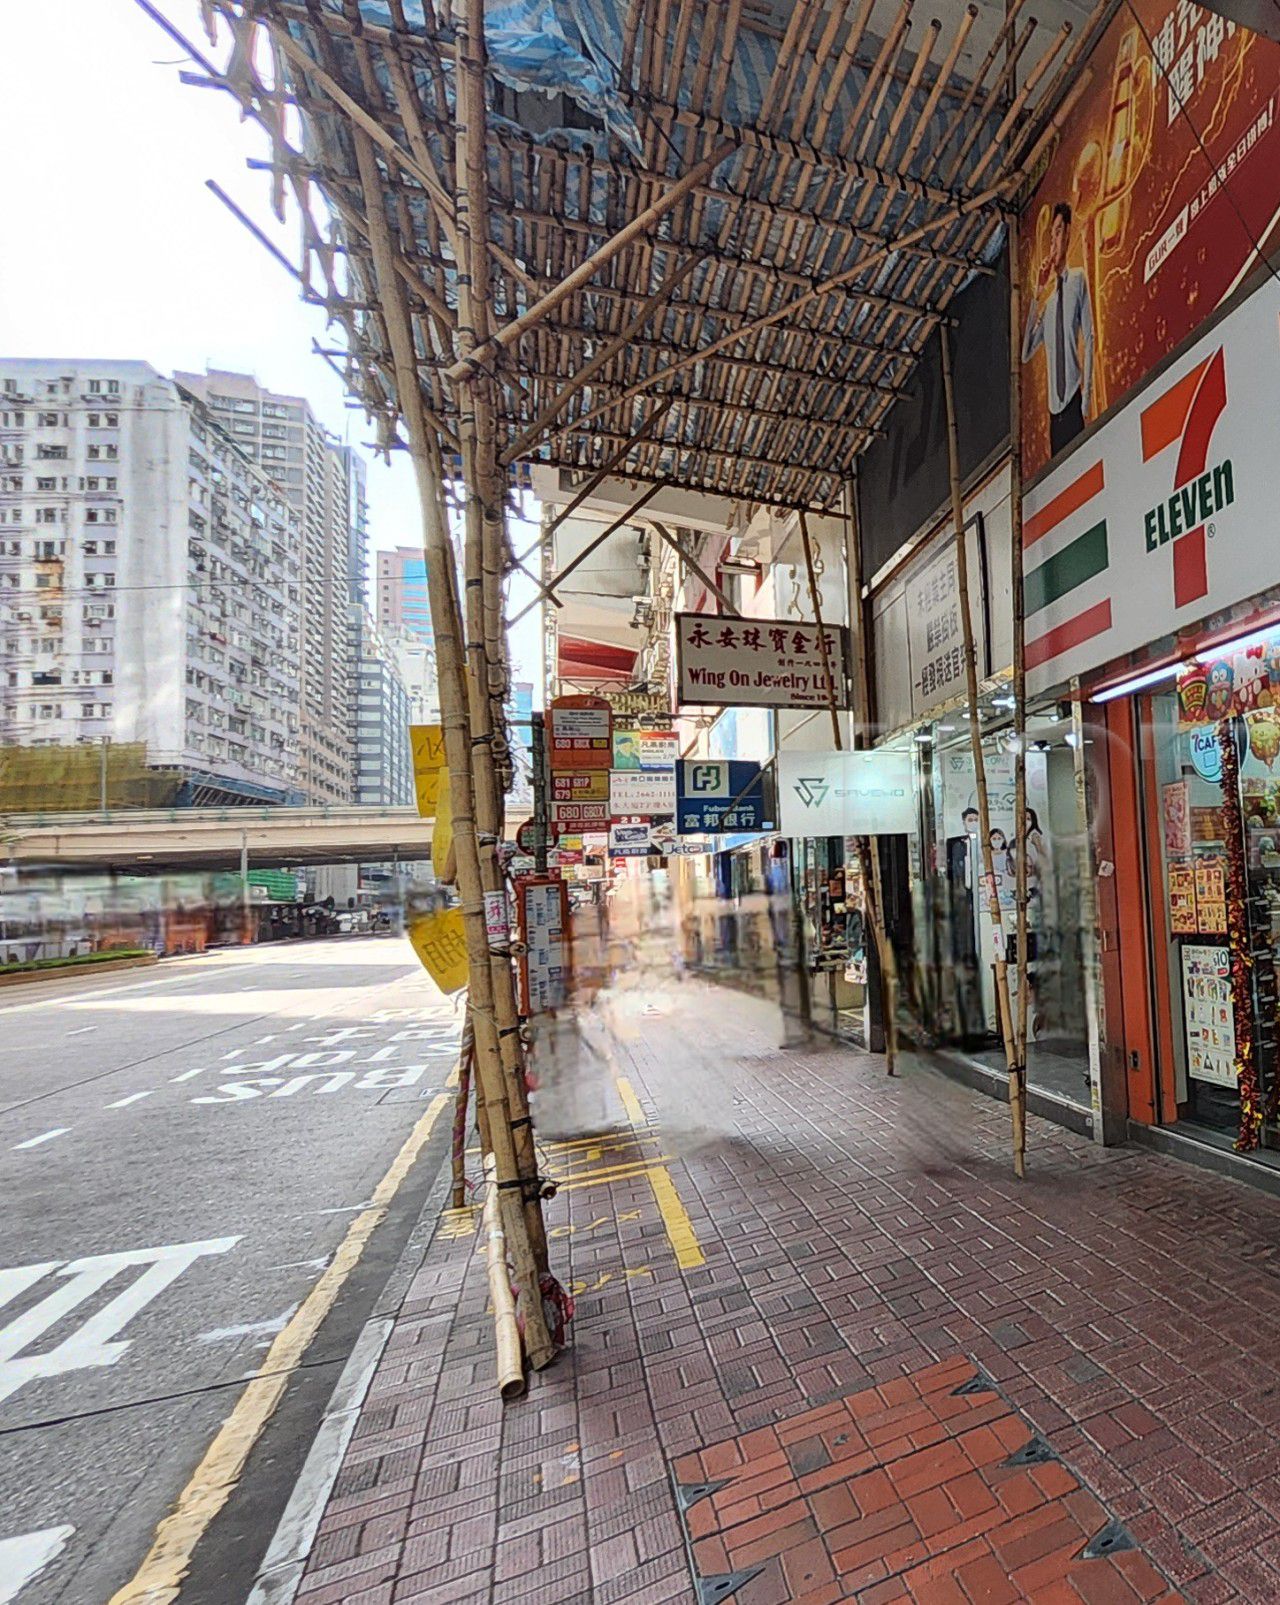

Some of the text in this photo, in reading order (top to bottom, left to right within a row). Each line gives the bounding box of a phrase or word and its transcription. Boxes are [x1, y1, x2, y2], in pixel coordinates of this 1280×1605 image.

[1167, 6, 1236, 128] 醒神
[1140, 345, 1227, 608] 7
[687, 622, 837, 656] 永安珠寶金行
[688, 667, 726, 690] Wing
[729, 669, 750, 687] On
[753, 671, 810, 692] Jewelry
[555, 790, 571, 799] 679
[559, 806, 580, 819] 680
[583, 805, 605, 819] 680X
[683, 812, 756, 829] 富邦銀行
[220, 1041, 461, 1075] STOP
[190, 1064, 429, 1104] BUS
